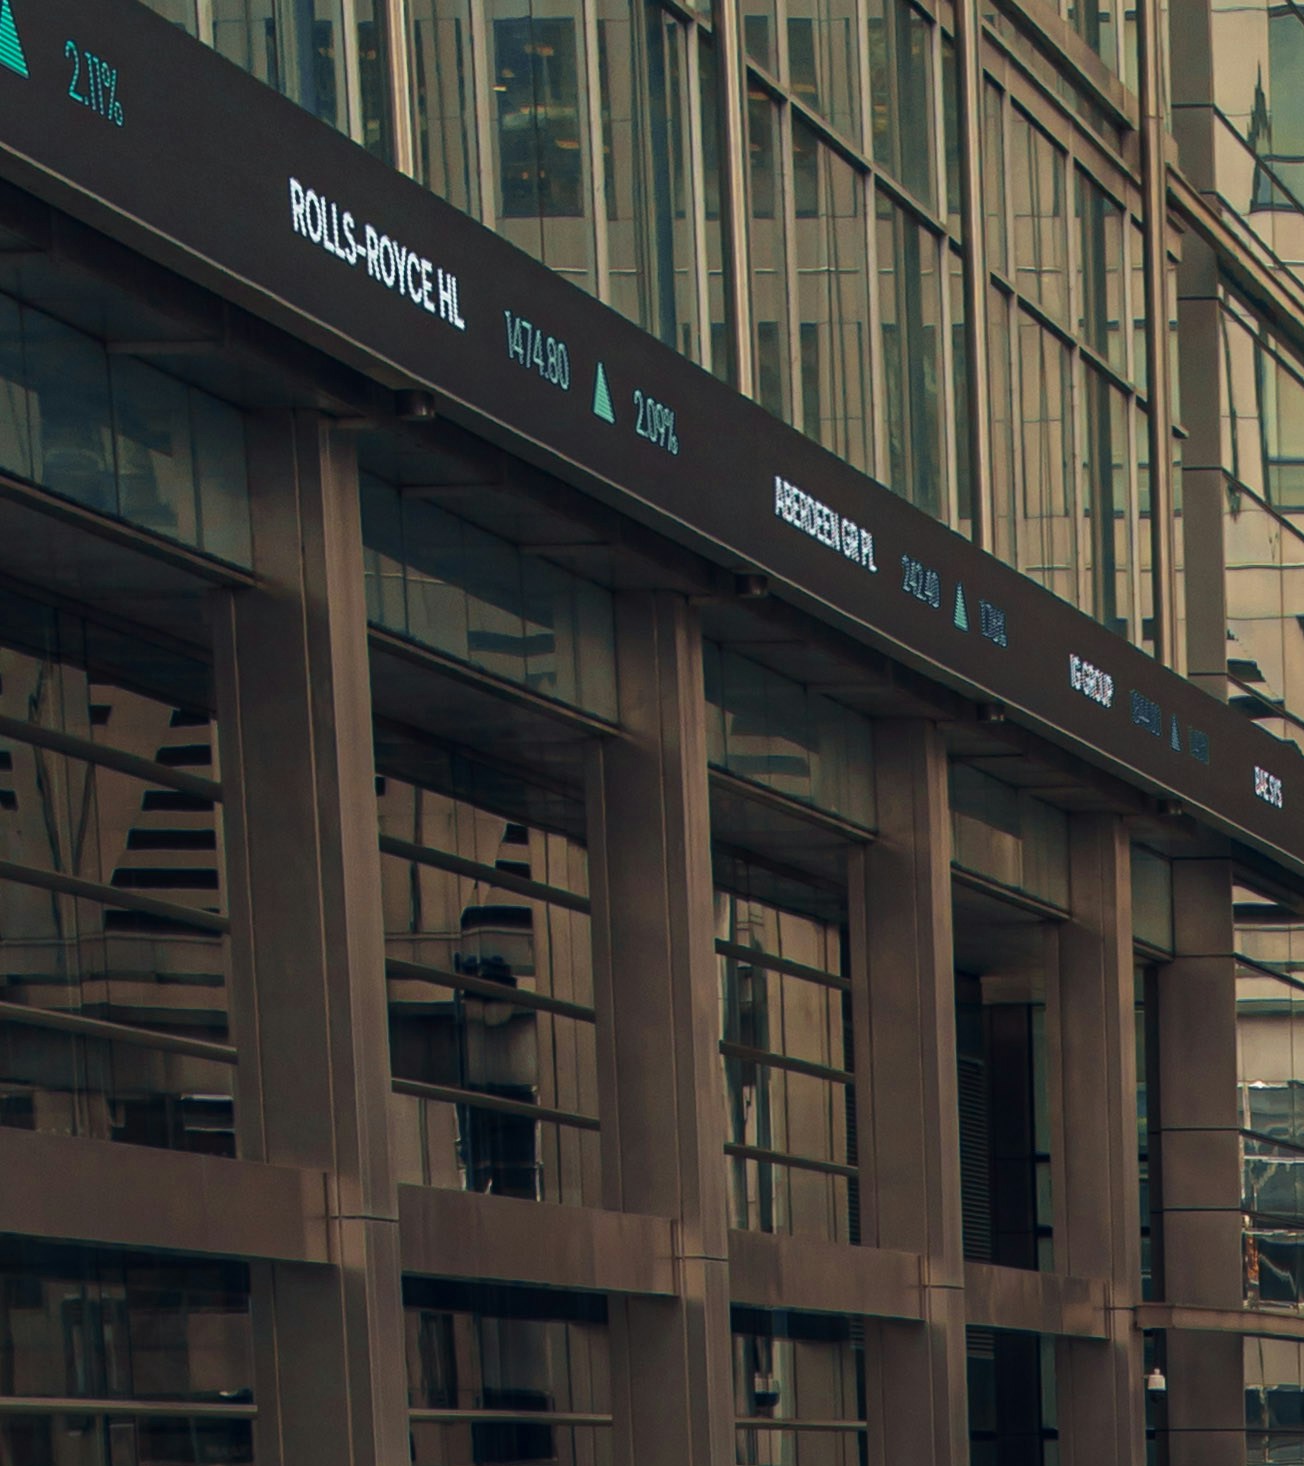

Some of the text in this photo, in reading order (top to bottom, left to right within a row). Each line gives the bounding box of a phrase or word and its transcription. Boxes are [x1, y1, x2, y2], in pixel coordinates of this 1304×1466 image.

[64, 40, 125, 127] 2.11%
[289, 177, 466, 331] ROLLS-ROYCE HL
[504, 309, 571, 391] 1474.80
[632, 388, 680, 456] 2.09%
[774, 476, 841, 551] ABERDEEN
[860, 527, 879, 574] PL
